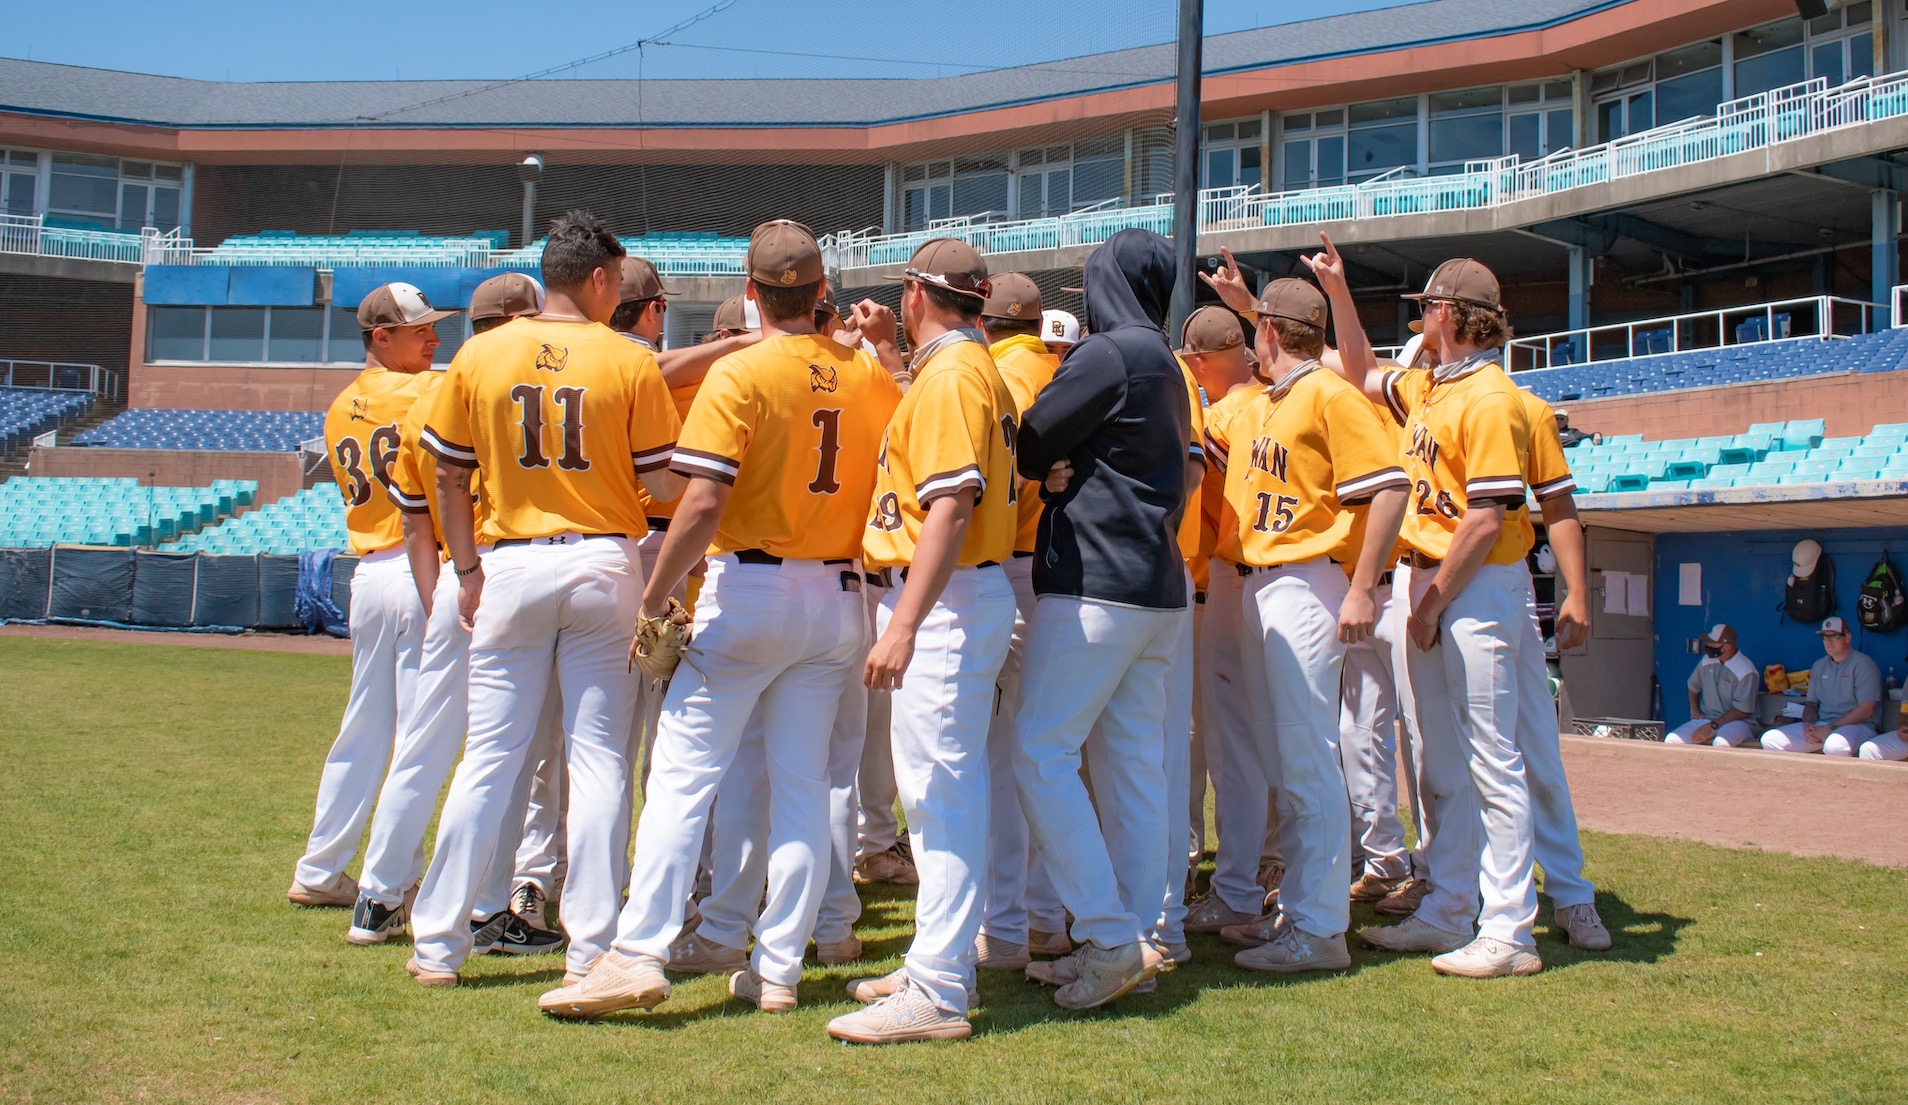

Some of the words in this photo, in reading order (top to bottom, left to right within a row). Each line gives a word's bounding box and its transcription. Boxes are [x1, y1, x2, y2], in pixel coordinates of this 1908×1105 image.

[335, 421, 401, 507] 36
[510, 383, 592, 472] 11
[808, 407, 845, 495] 1
[1252, 491, 1299, 533] 15
[1415, 478, 1459, 519] 26
